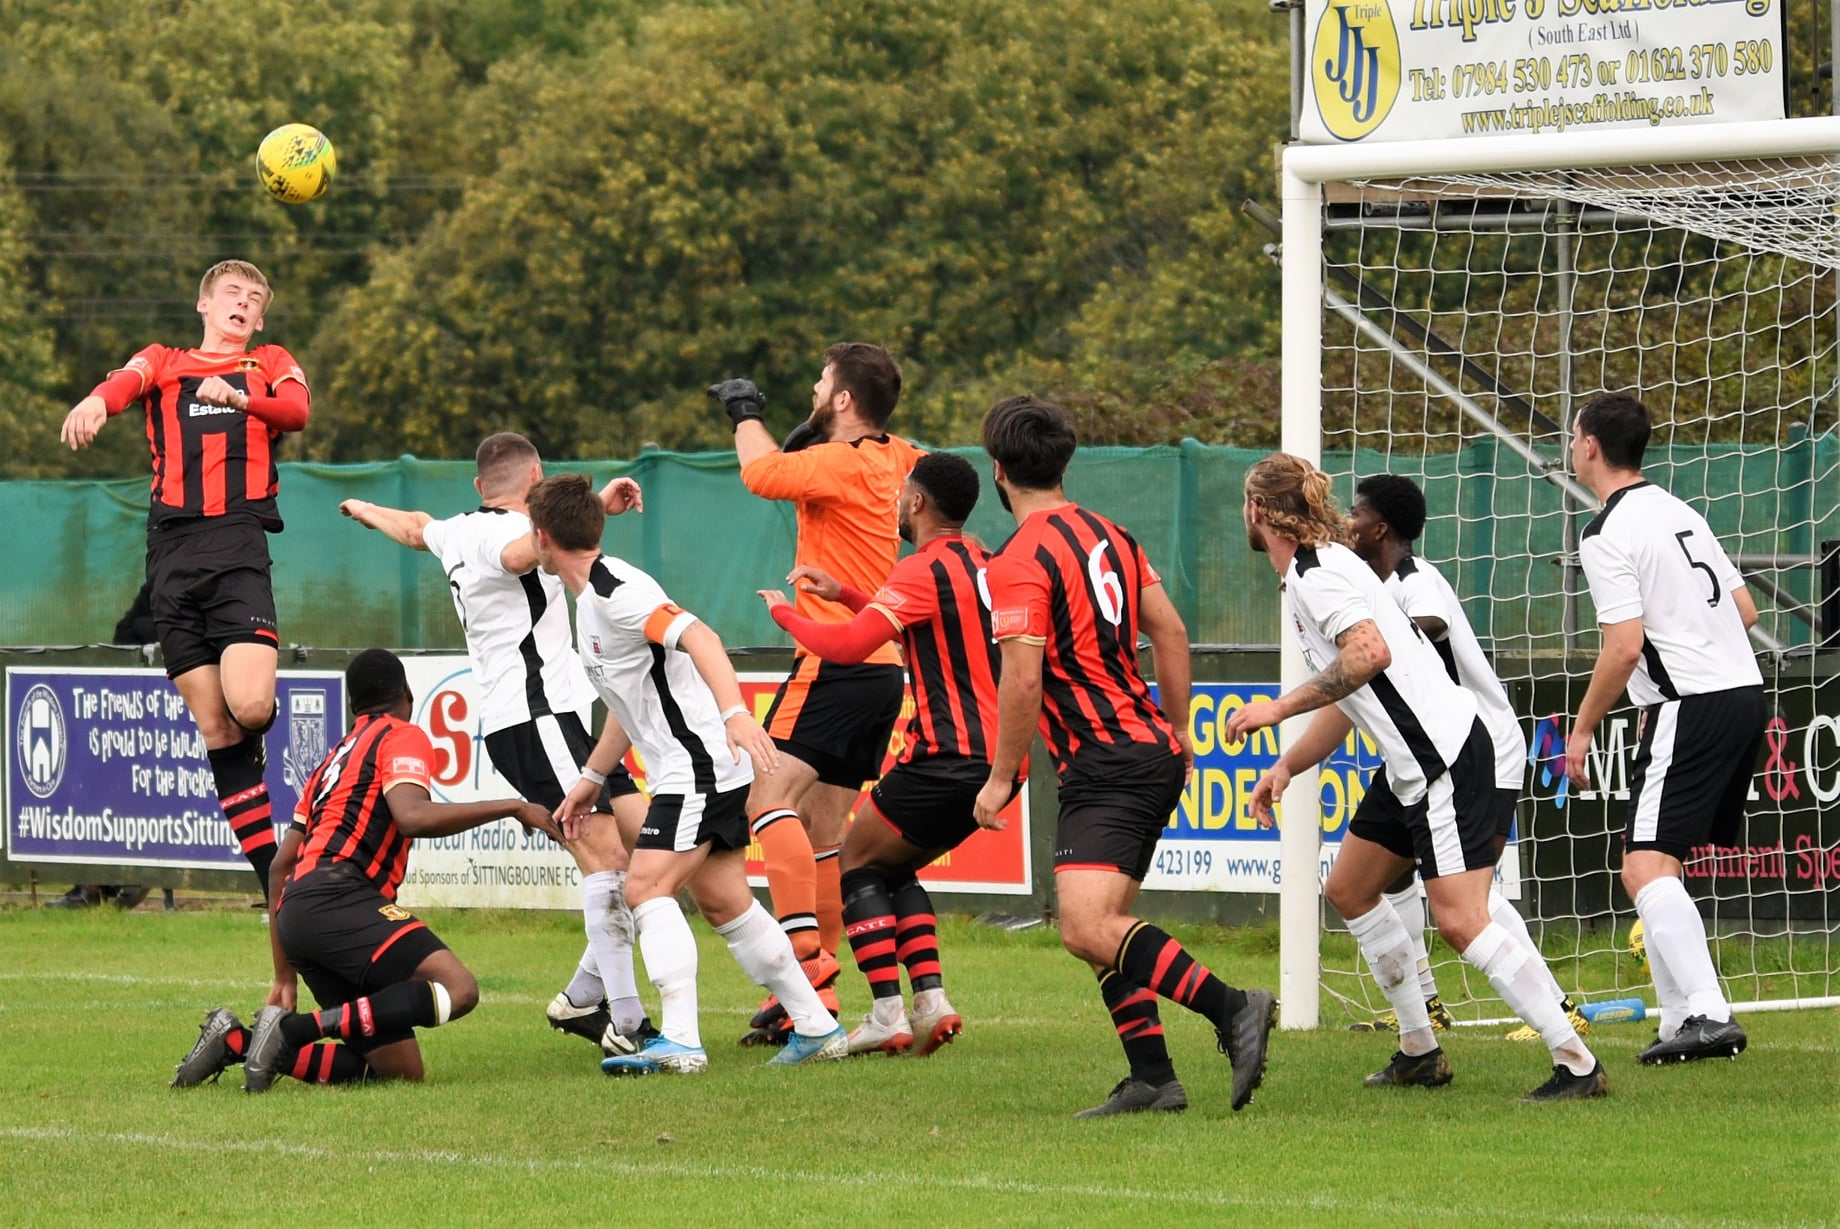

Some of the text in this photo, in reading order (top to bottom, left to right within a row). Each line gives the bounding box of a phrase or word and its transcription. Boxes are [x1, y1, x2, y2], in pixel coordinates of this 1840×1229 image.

[1353, 4, 1383, 22] Triple
[1408, 38, 1773, 102] Tel: 07984 530 473 or 01622 370 580
[1461, 86, 1715, 134] www.triplejscaffolding.co.uk
[1087, 538, 1123, 627] 6
[1674, 530, 1721, 608] 5
[420, 868, 459, 886] Sponsors
[472, 865, 562, 887] SITTINGBOURNE
[565, 866, 579, 887] FC
